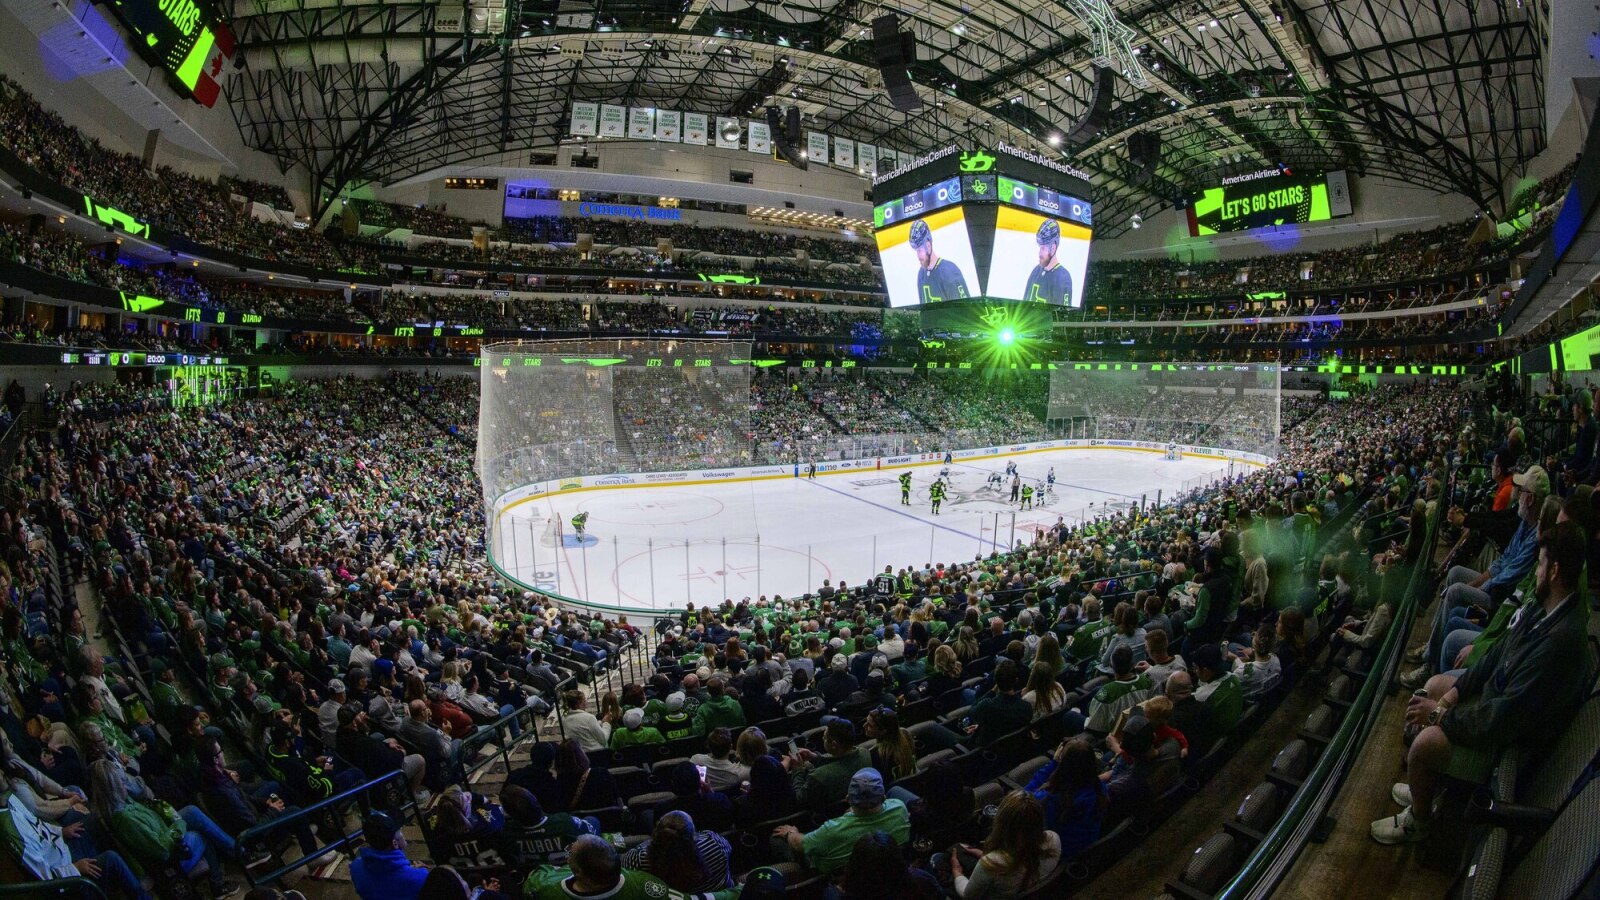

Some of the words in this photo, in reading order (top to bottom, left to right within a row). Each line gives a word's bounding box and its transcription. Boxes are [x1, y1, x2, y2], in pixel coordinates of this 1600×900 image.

[1222, 173, 1255, 186] American
[1254, 168, 1281, 179] Airlines
[1221, 197, 1250, 220] LET'S
[1252, 193, 1266, 212] GO
[1268, 185, 1305, 210] STARS
[648, 205, 681, 220] Bank
[217, 311, 225, 324] GO
[433, 328, 441, 337] GO
[122, 353, 129, 364] 0
[147, 355, 166, 364] 20:00
[182, 354, 188, 364] 0
[502, 358, 511, 367] GO
[524, 358, 541, 367] STARS
[647, 358, 662, 367] LET'S
[674, 359, 682, 367] GO
[694, 359, 712, 367] STARS
[802, 360, 815, 368] LET'S
[841, 360, 856, 368] STARS
[878, 580, 890, 594] 91
[454, 840, 479, 856] OTT
[516, 837, 563, 853] ZUBOV
